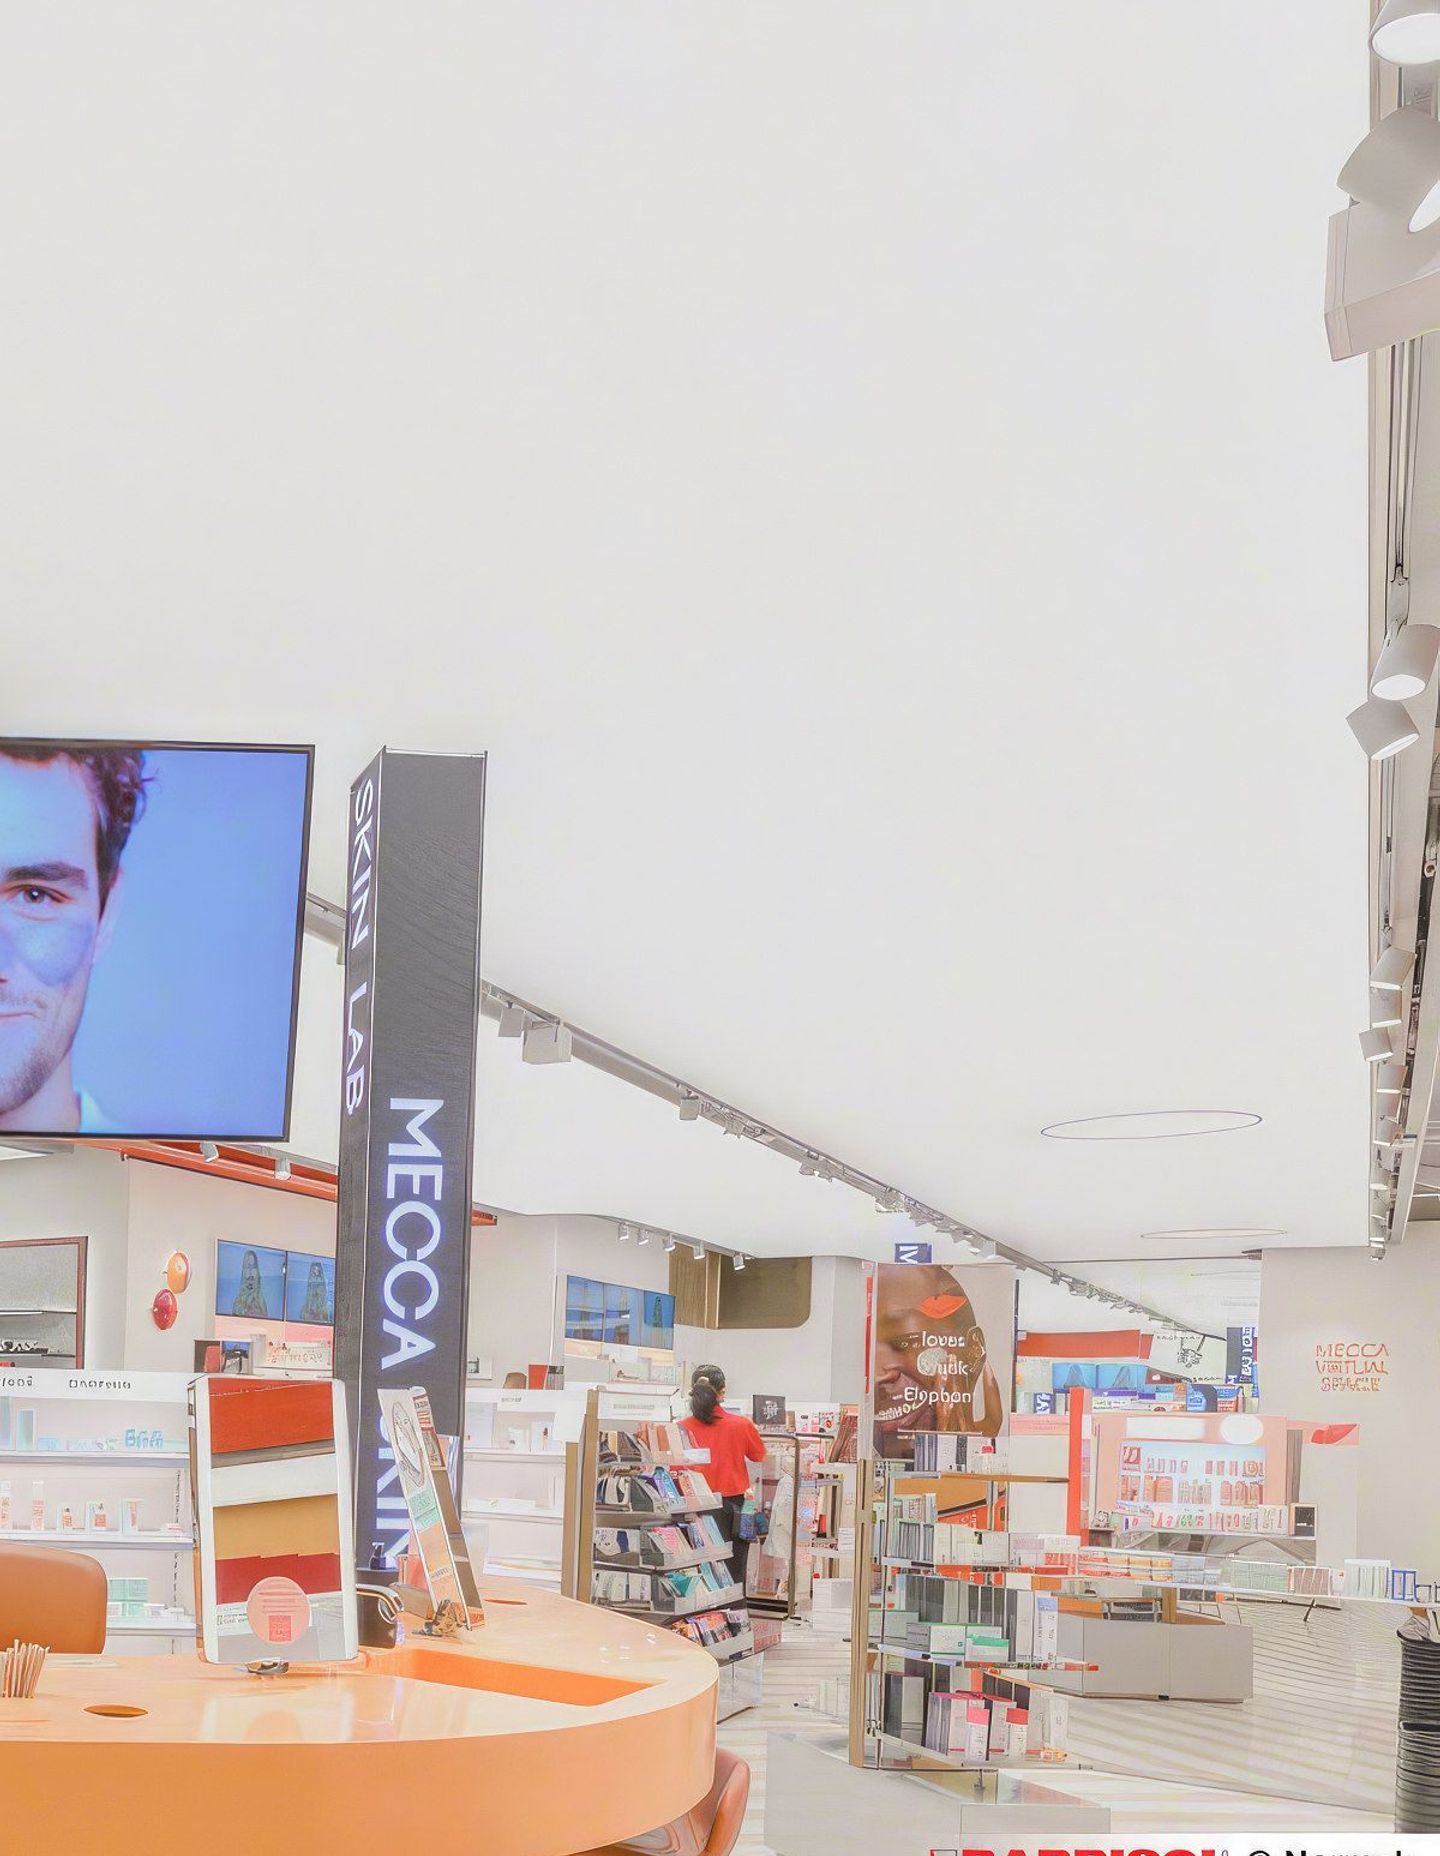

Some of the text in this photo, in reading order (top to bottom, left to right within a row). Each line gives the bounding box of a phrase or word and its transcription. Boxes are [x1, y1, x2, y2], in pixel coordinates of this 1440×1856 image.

[346, 778, 374, 1116] SKIN LAB
[381, 1097, 445, 1371] MECCA
[1316, 1343, 1389, 1358] MECCA
